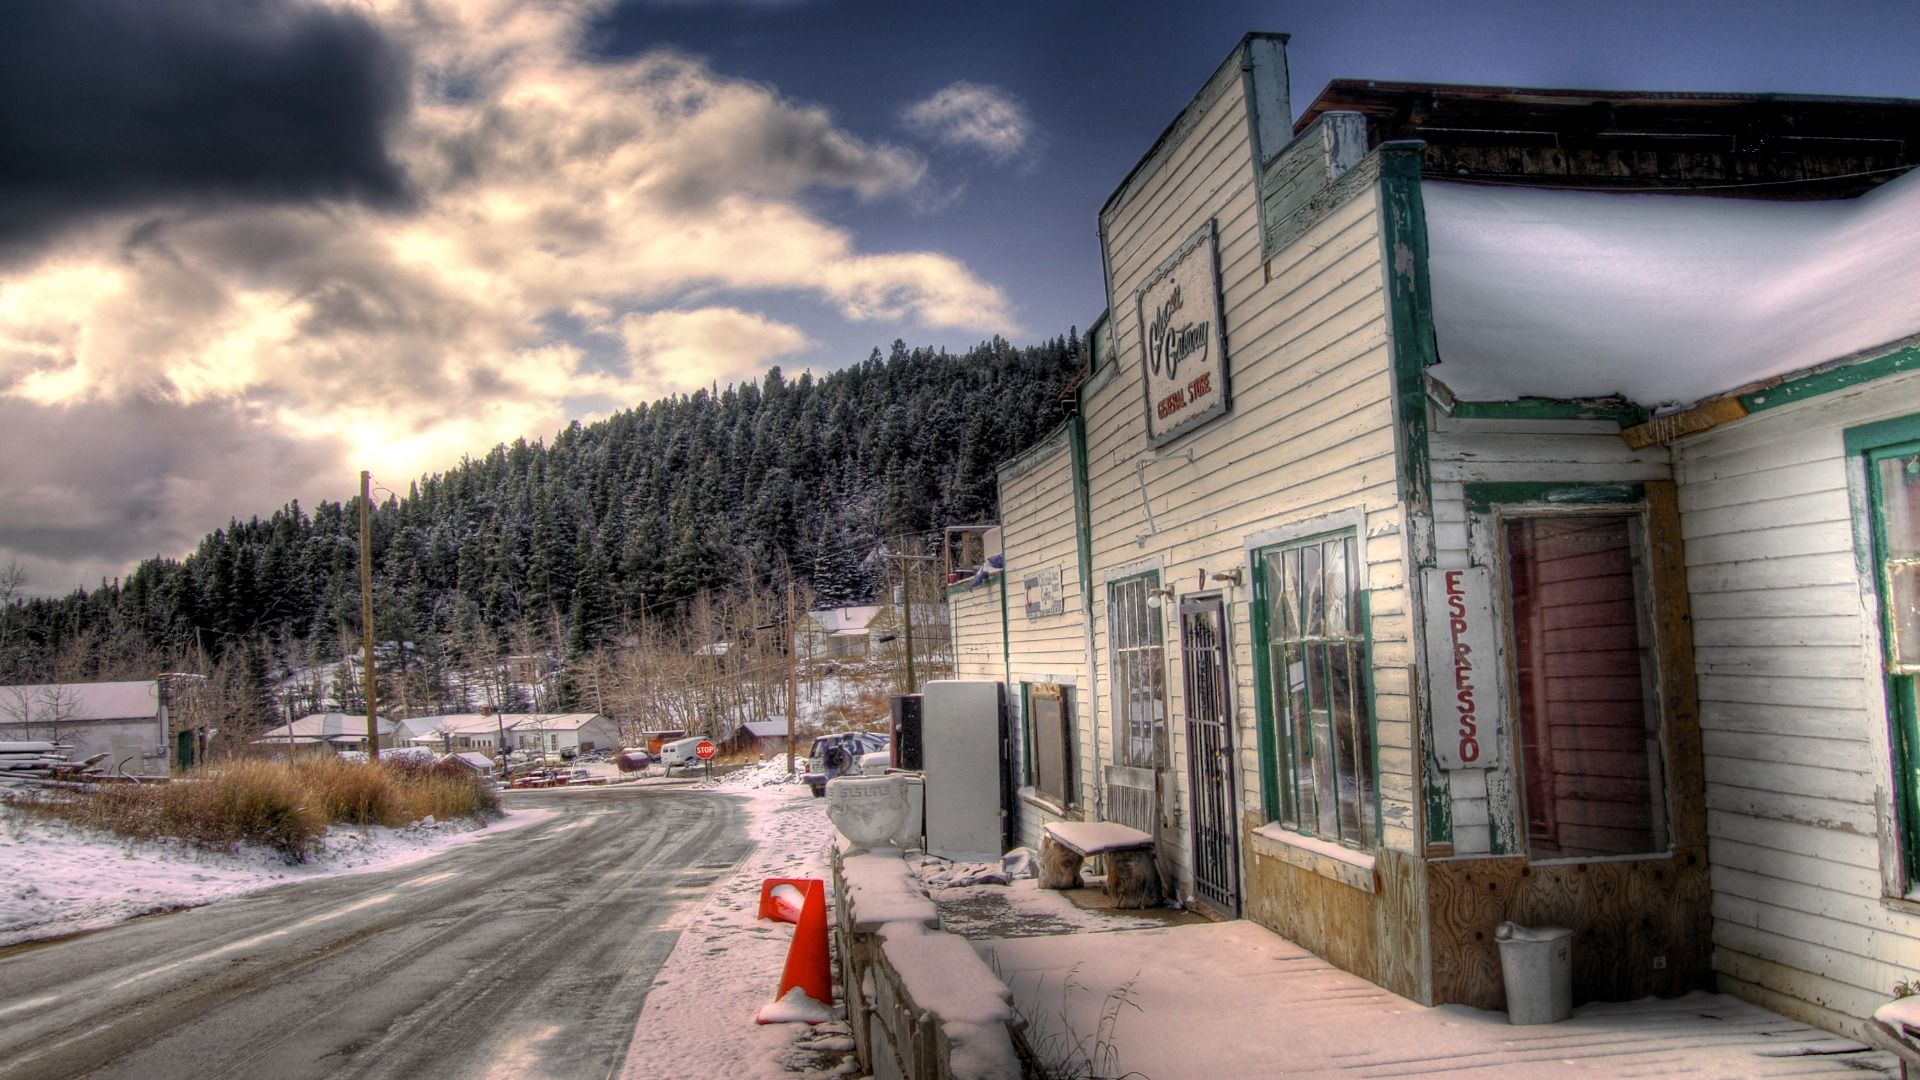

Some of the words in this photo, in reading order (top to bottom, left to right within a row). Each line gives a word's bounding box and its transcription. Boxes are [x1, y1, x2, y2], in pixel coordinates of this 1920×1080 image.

[1157, 388, 1187, 420] GENERAL
[1188, 371, 1212, 403] STORE
[1445, 570, 1480, 763] ESPRESSO
[696, 746, 714, 754] STOP
